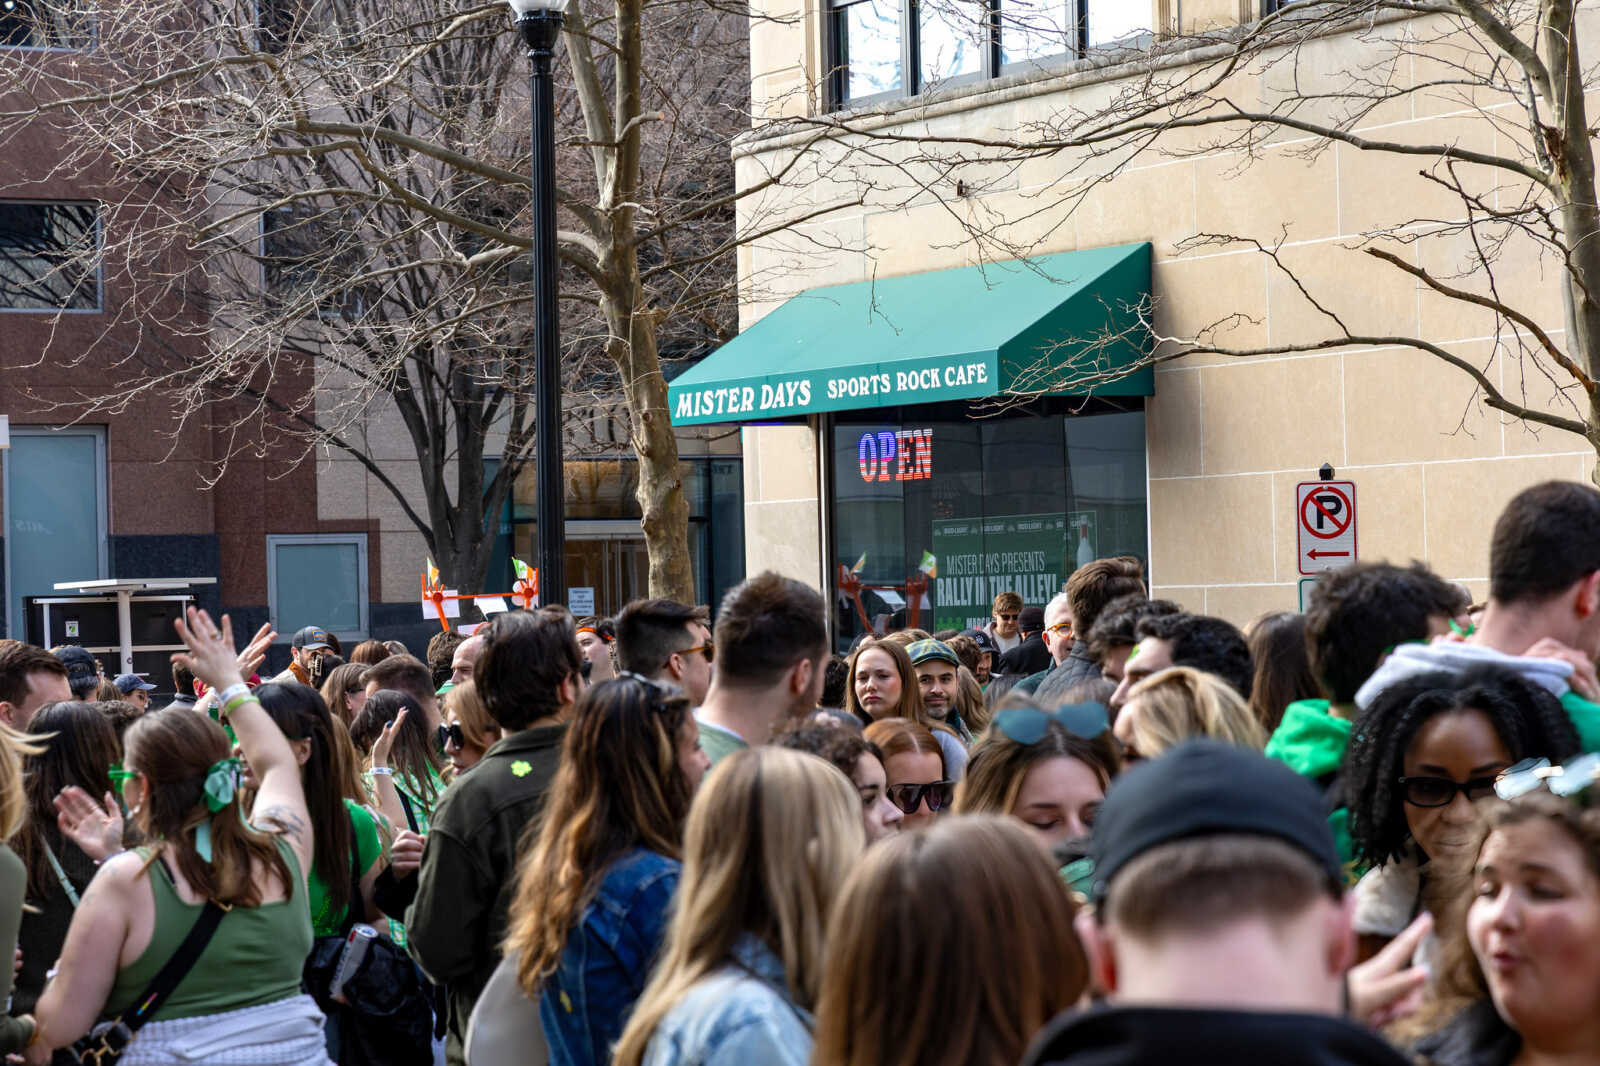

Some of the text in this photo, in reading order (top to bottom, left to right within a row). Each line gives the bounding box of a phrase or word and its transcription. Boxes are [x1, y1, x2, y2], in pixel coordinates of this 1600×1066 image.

[675, 362, 988, 418] MISTER DAYS SPORTS ROCK CAFE
[859, 428, 932, 482] OPEN
[1316, 495, 1342, 529] P
[946, 554, 977, 575] MISTER
[1002, 551, 1045, 573] PRESENTS
[937, 576, 972, 607] RALLY
[976, 575, 987, 606] IN
